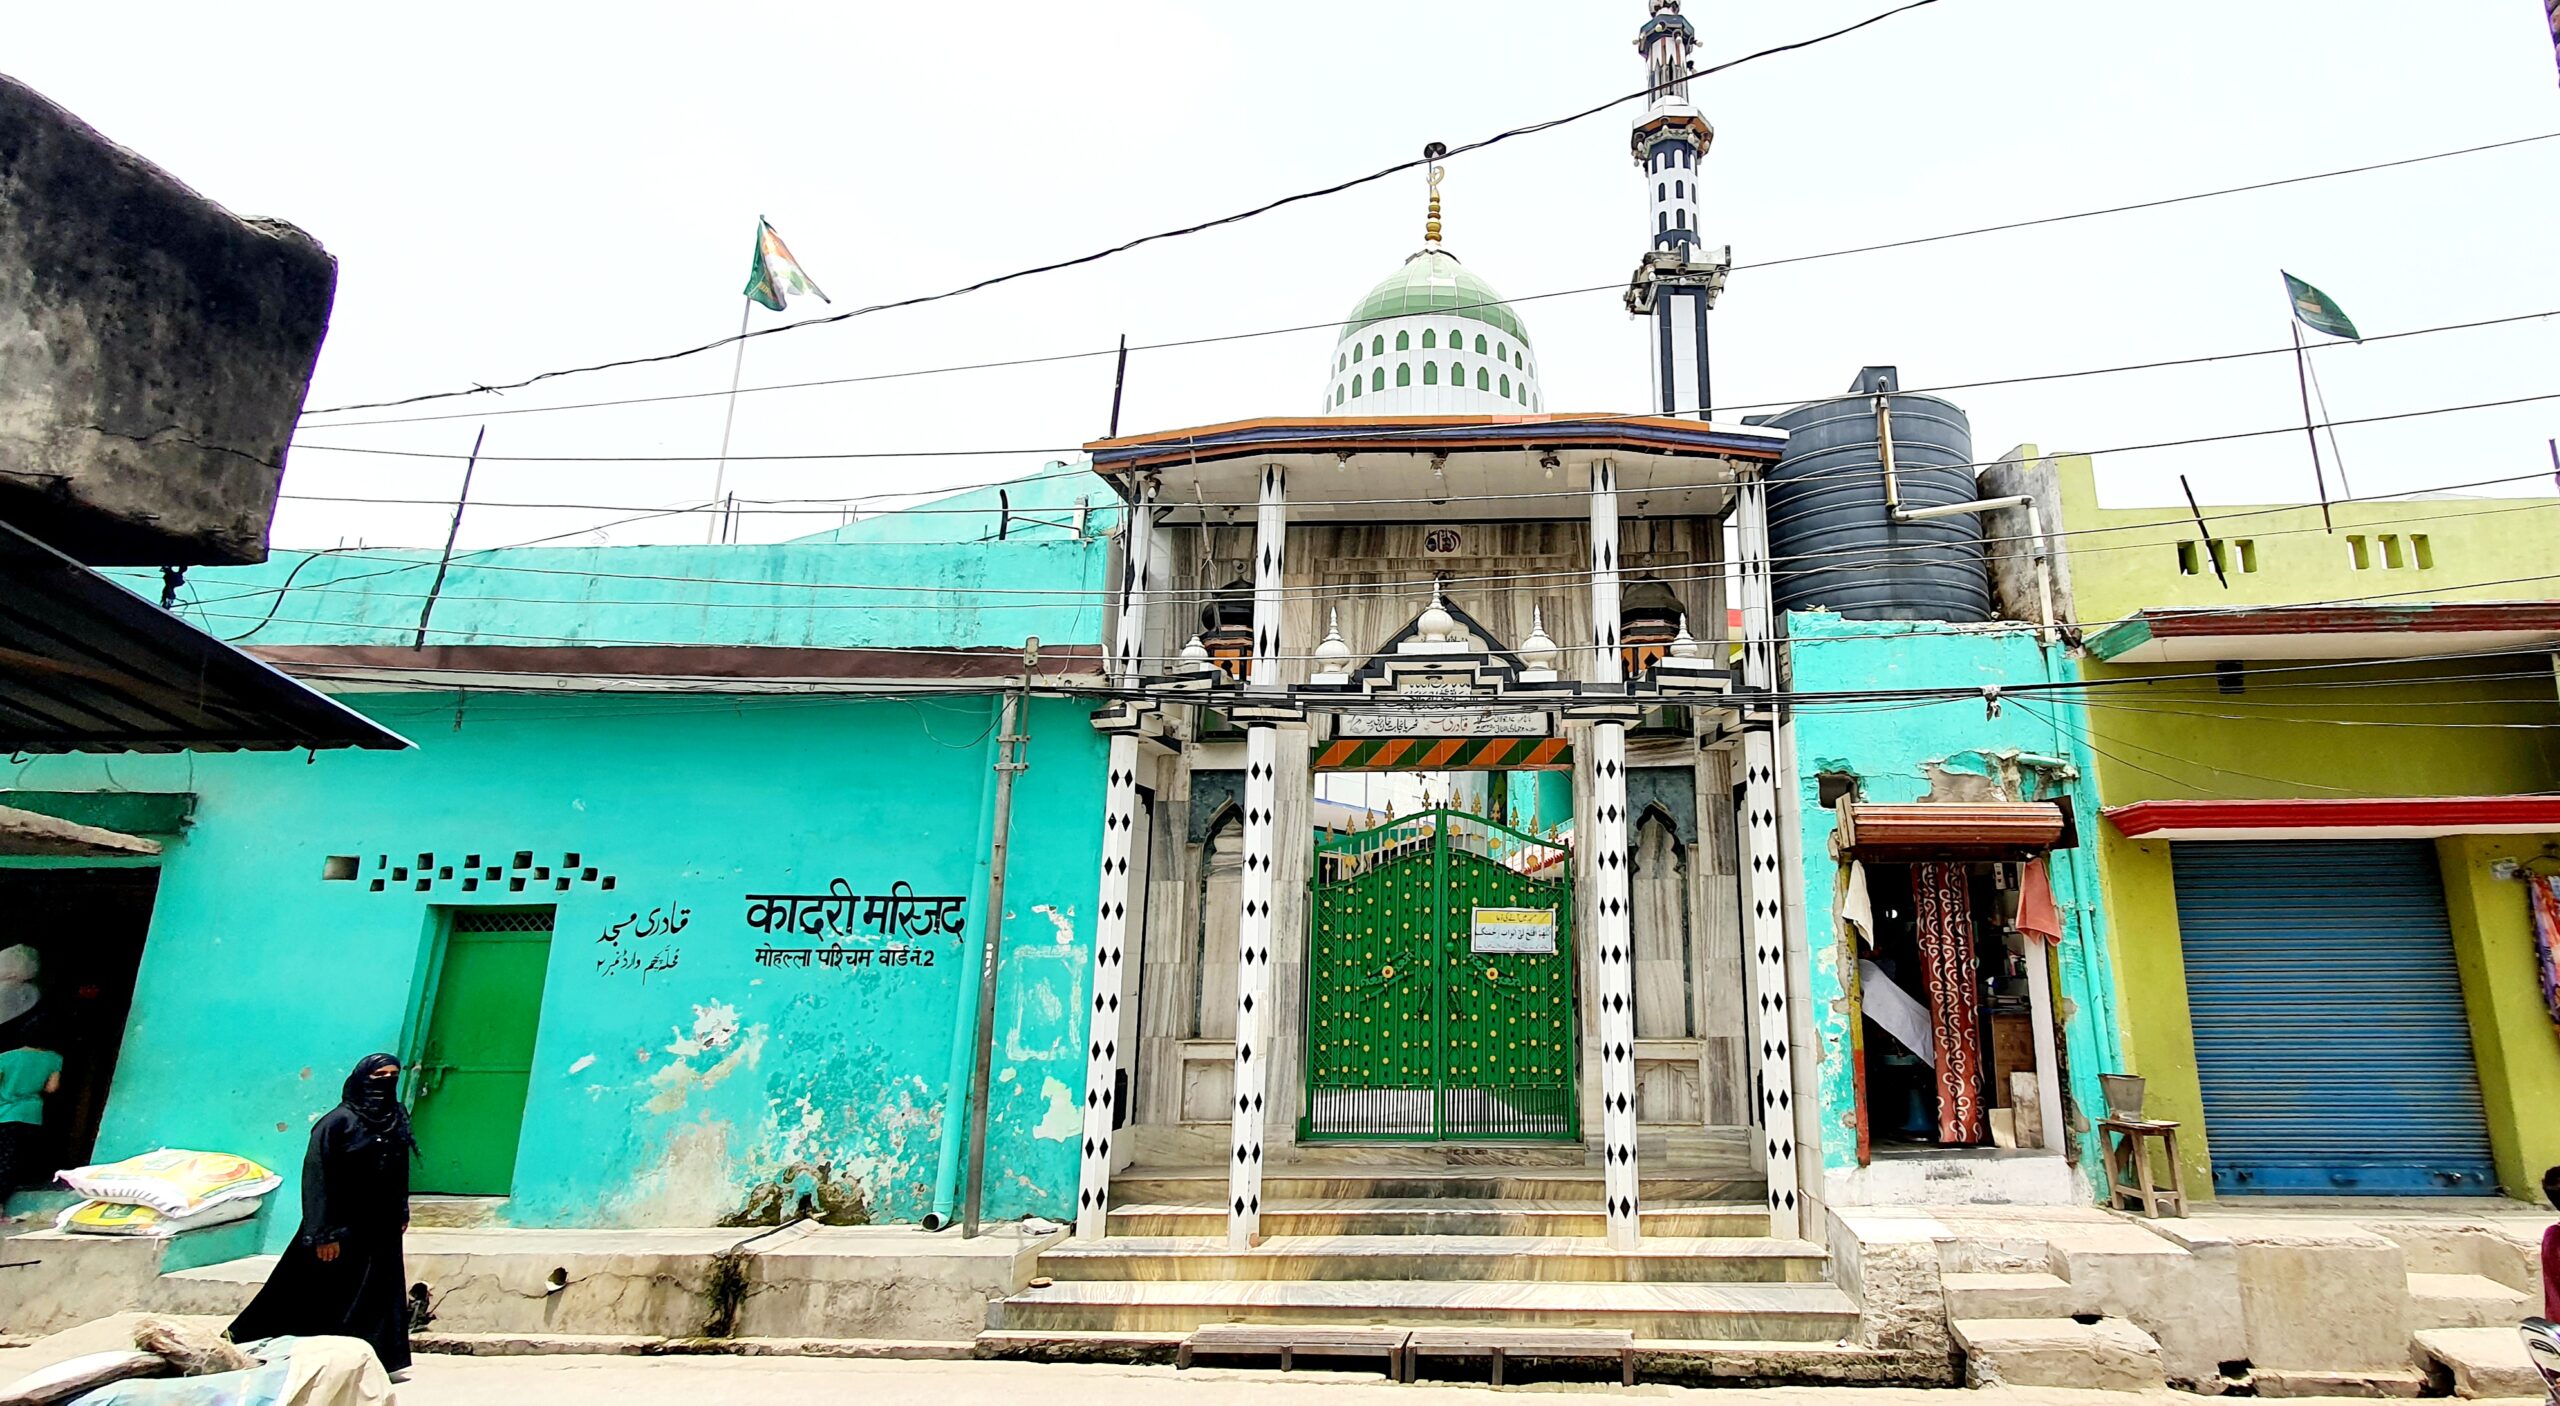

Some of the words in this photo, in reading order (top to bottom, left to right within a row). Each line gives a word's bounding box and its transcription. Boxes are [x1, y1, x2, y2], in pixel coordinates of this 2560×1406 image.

[634, 899, 692, 938] قادری
[745, 877, 861, 942] कादरी
[863, 880, 966, 943] मस्जिद
[595, 912, 637, 948] مسجد
[755, 942, 812, 969] मोहल्ला
[816, 942, 874, 971] पश्चिम
[878, 944, 910, 967] वार्ड
